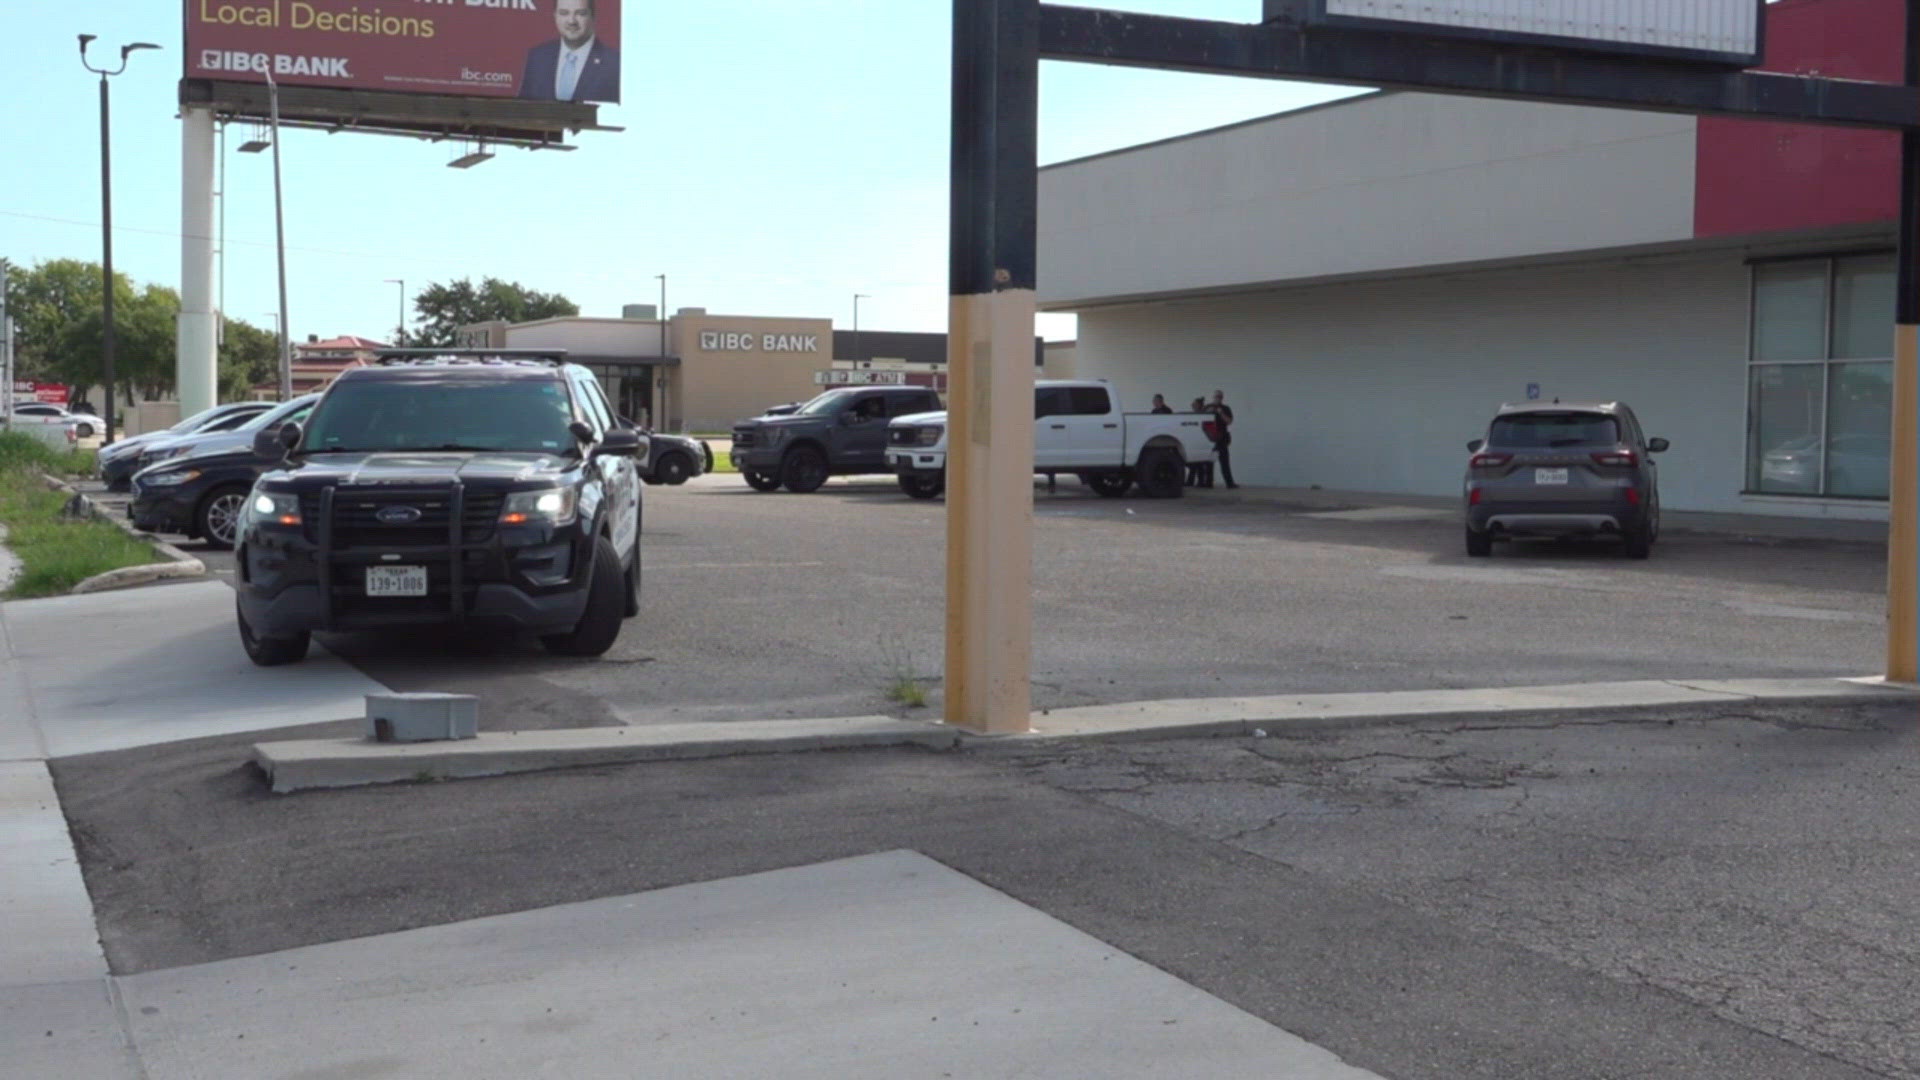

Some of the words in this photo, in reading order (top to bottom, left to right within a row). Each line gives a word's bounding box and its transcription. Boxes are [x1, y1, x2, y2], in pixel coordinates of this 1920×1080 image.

[465, 0, 537, 11] ank
[201, 0, 280, 28] Local
[291, 2, 435, 38] Decisions
[224, 51, 269, 73] IBC
[275, 54, 351, 78] BANK
[461, 68, 513, 82] ibc.com
[720, 333, 753, 350] IBC
[763, 334, 817, 352] BANK
